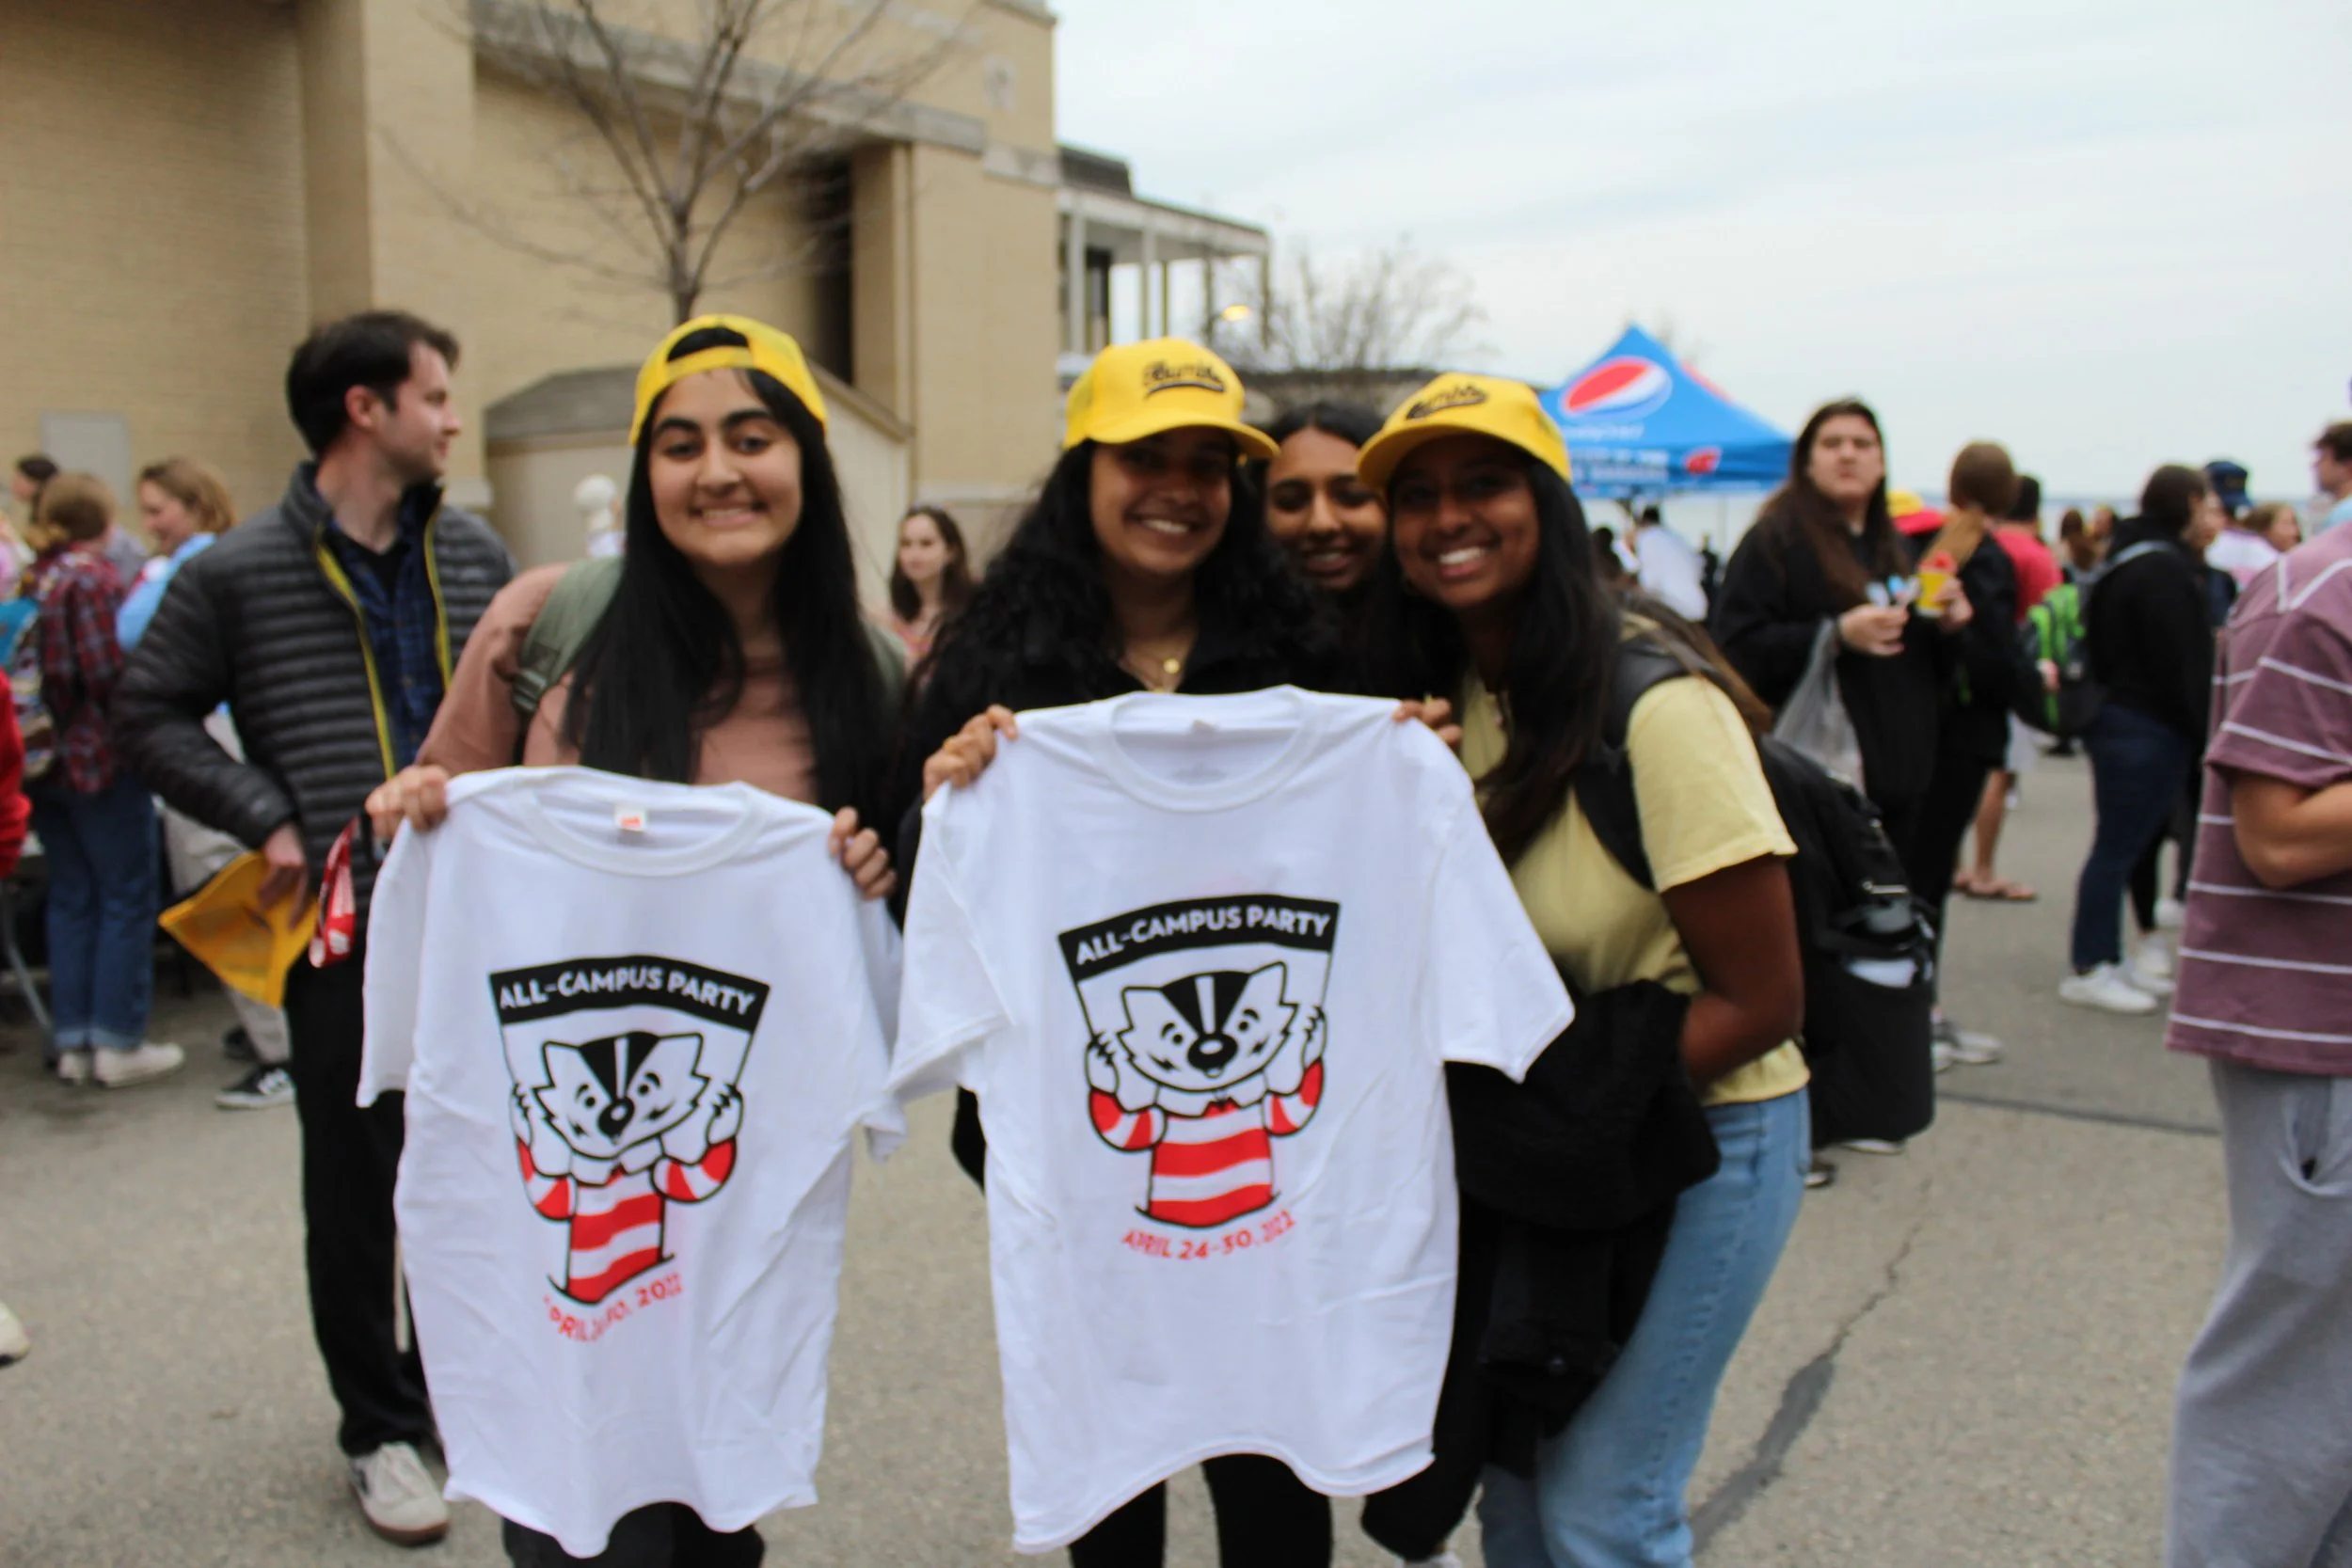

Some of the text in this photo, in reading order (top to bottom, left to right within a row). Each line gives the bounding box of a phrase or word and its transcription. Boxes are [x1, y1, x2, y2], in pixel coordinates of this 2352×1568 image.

[1076, 904, 1329, 965] ALL-CAMPUS PARTY
[500, 966, 756, 1016] ALL-CAMPUS PARTY
[1121, 1228, 1172, 1259] APRIL
